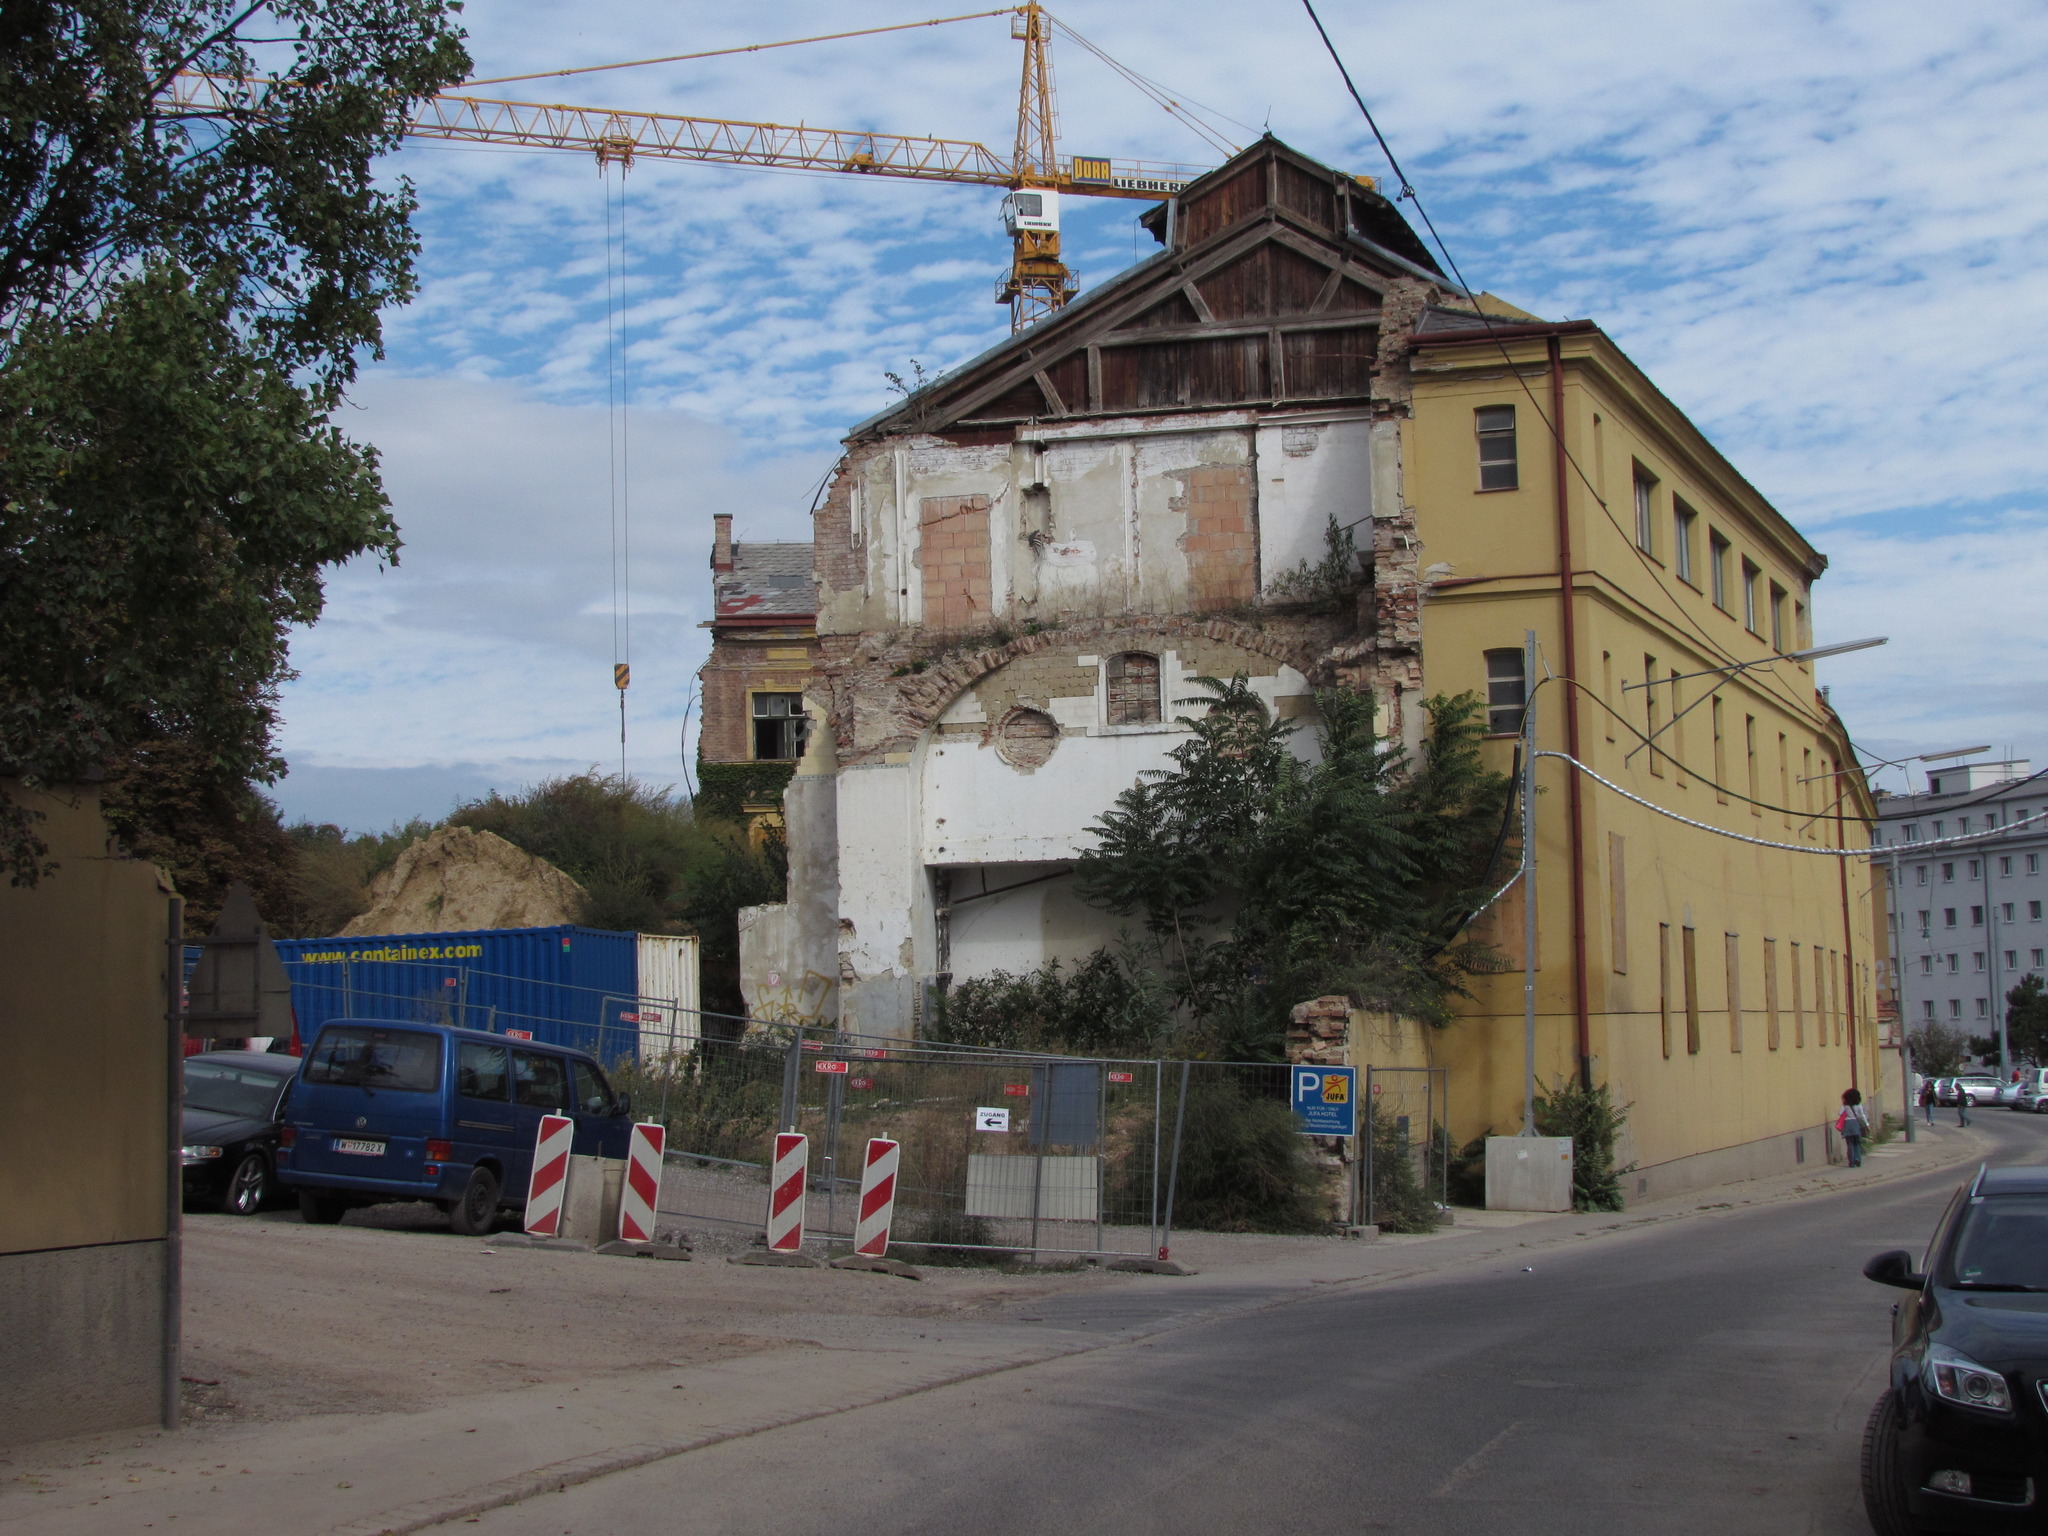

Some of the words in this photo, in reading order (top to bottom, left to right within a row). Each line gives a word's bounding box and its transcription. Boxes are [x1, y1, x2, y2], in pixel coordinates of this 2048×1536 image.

[302, 945, 482, 964] www.containex.com
[1298, 1072, 1320, 1102] P
[1326, 1092, 1345, 1101] JUFA
